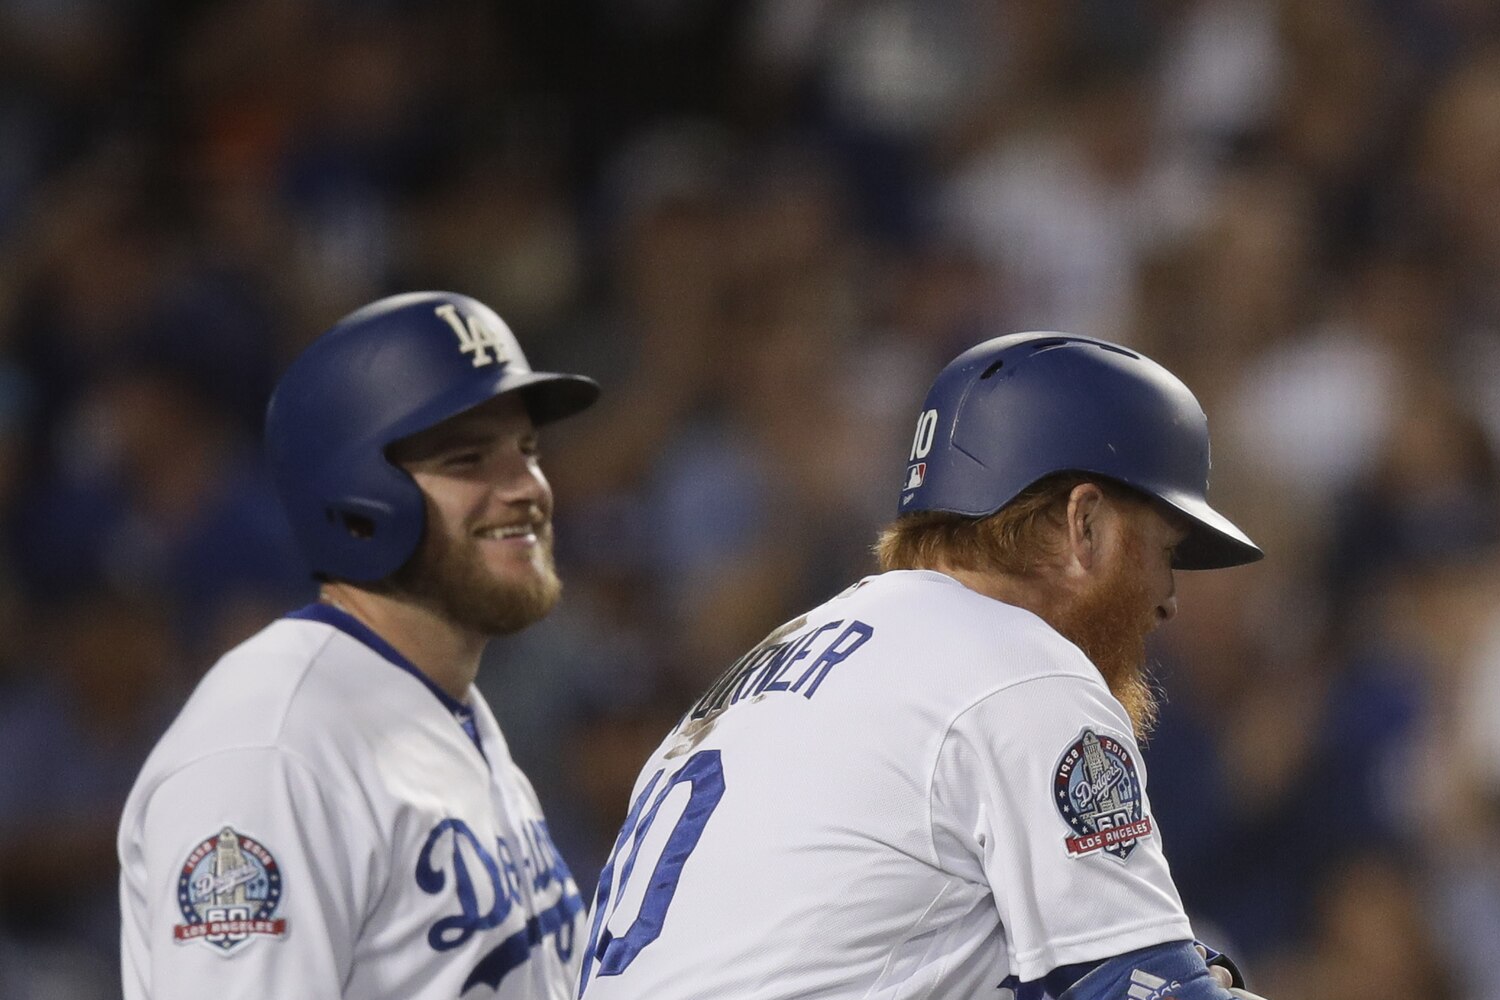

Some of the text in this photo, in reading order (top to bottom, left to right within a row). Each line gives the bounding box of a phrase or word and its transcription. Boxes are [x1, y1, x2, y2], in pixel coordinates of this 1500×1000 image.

[434, 304, 508, 368] LA
[910, 408, 938, 461] 10
[672, 619, 874, 737] URNER
[1060, 748, 1079, 778] 1958
[1075, 760, 1123, 808] Dodgers
[1079, 822, 1148, 850] LOS ANGELES
[577, 749, 727, 1000] 10
